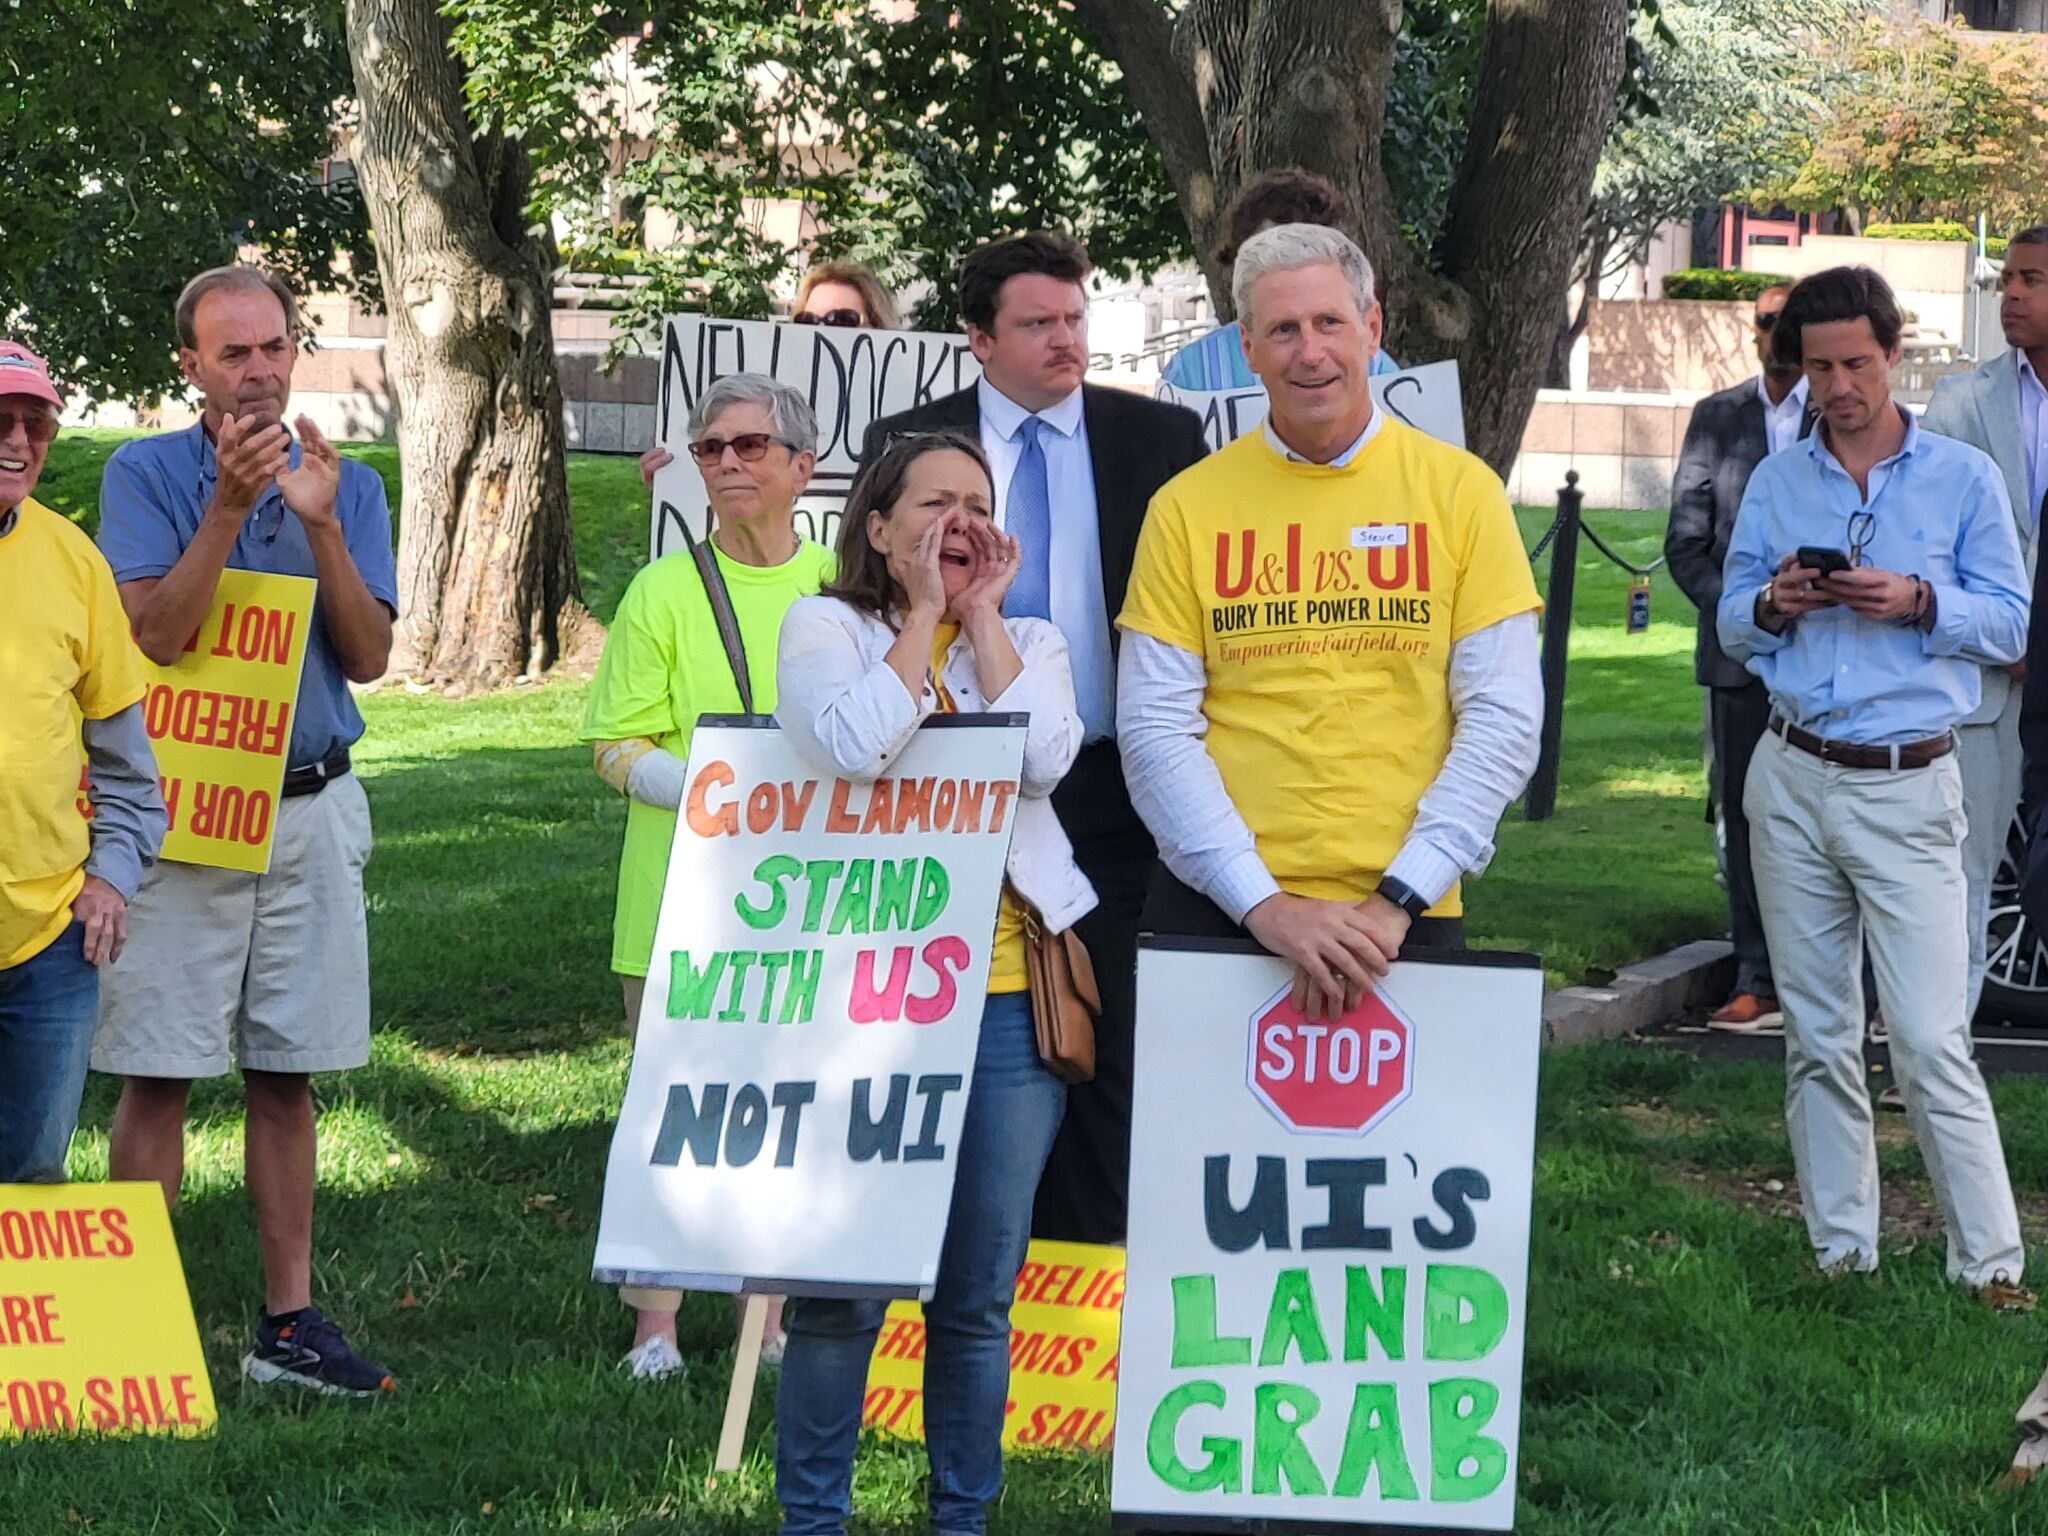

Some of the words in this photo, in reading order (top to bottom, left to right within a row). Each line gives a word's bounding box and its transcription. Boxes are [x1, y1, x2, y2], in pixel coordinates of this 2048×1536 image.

[1215, 523, 1302, 599] U&I
[1367, 522, 1431, 591] UI
[210, 603, 296, 665] NOT
[1212, 602, 1259, 633] BURY
[1264, 599, 1299, 626] THE
[1306, 597, 1371, 625] POWER
[1379, 597, 1431, 625] LINES
[142, 683, 290, 757] FREEDO
[190, 781, 272, 845] OUR
[824, 776, 1018, 837] LAMONT
[734, 854, 951, 935] STAND
[665, 949, 824, 1024] WITH
[848, 935, 971, 1025] US
[1259, 1023, 1401, 1087] STOP
[649, 1081, 816, 1168] NOT
[846, 1073, 964, 1163] UI
[0, 1207, 135, 1261] OMES
[1014, 1262, 1125, 1310] RELIG
[1171, 1263, 1510, 1369] LAND
[0, 1294, 65, 1346] RE
[84, 1374, 202, 1430] SALE
[1016, 1403, 1114, 1450] SAL
[1146, 1377, 1509, 1504] GRAB
